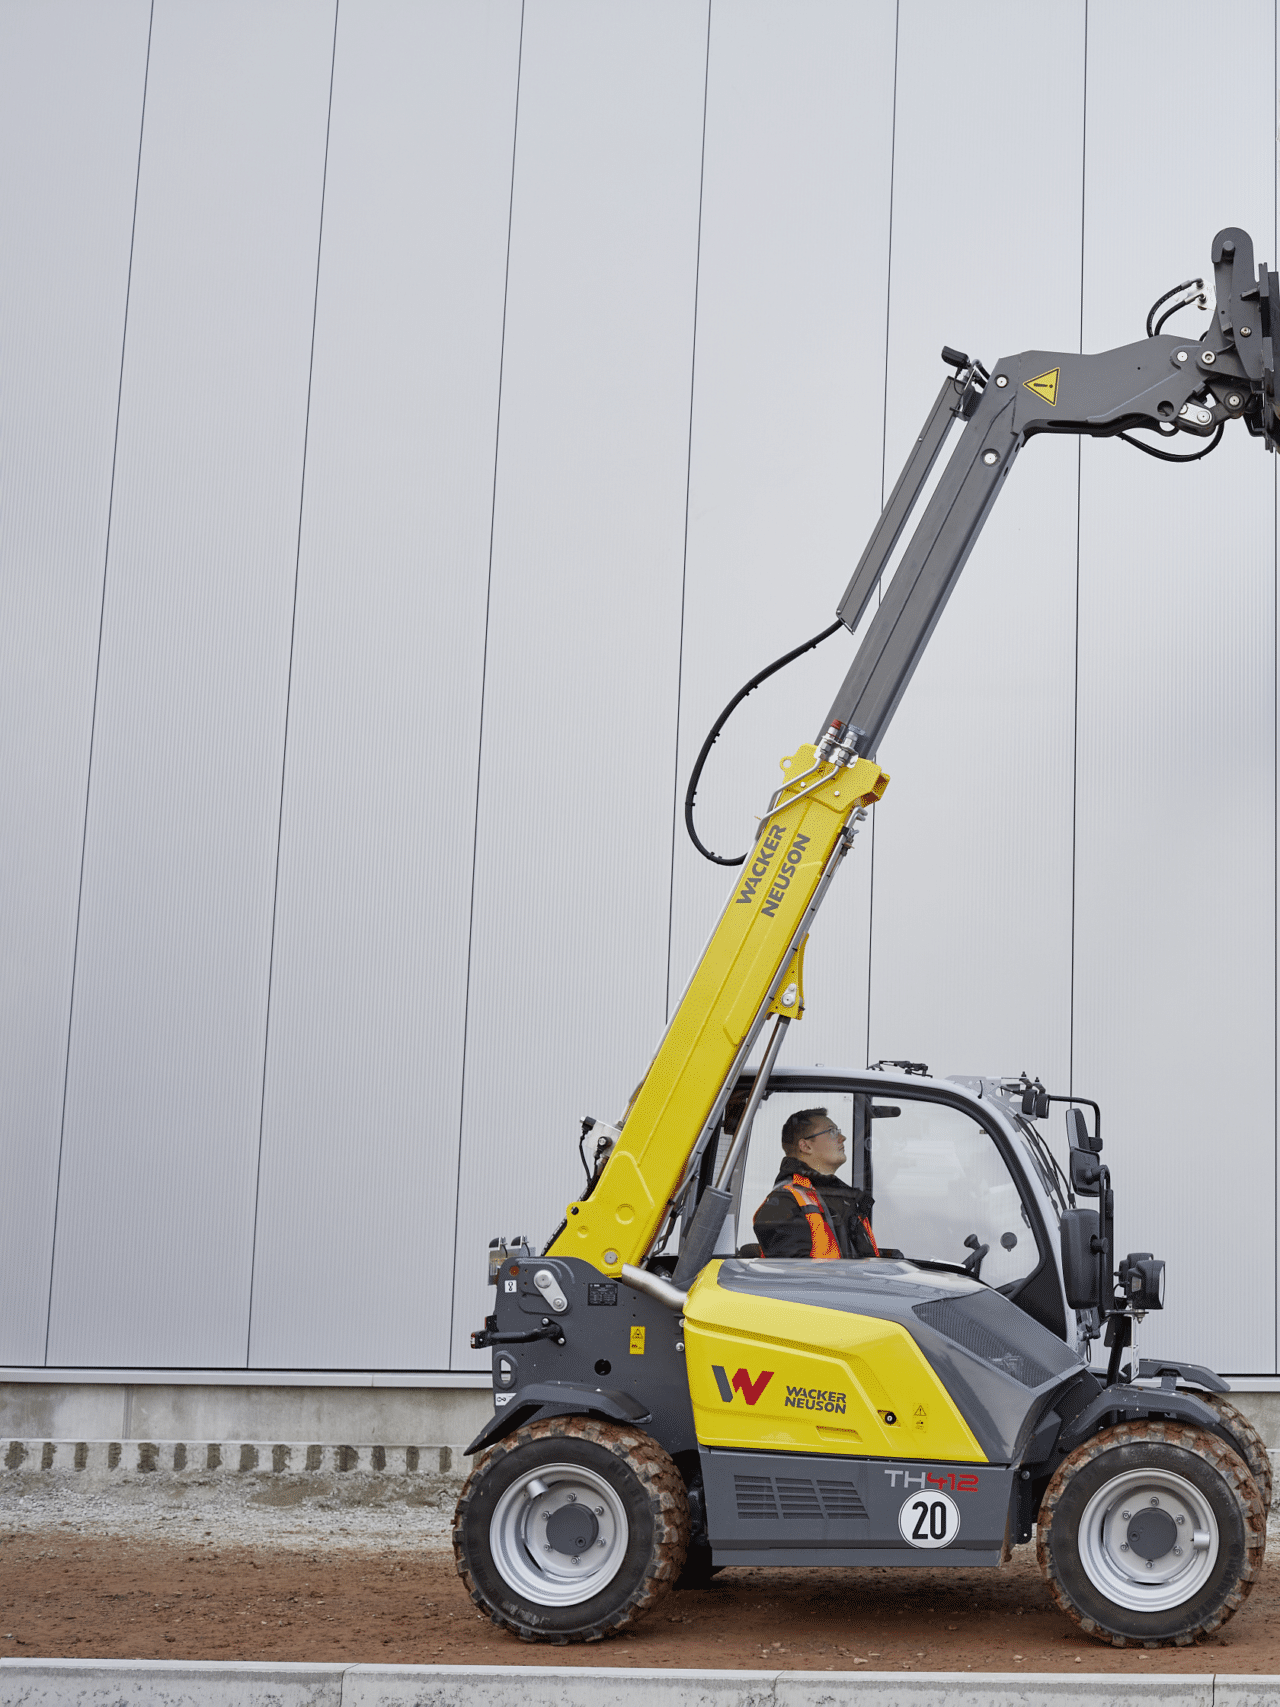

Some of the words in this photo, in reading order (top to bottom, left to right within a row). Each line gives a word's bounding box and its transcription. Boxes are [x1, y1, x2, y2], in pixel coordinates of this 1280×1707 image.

[736, 824, 786, 903] WACKER
[761, 833, 810, 918] NEUSON
[785, 1396, 846, 1414] NEUSON
[786, 1386, 846, 1403] WACKER
[884, 1470, 979, 1492] TH412
[912, 1501, 946, 1540] 20
